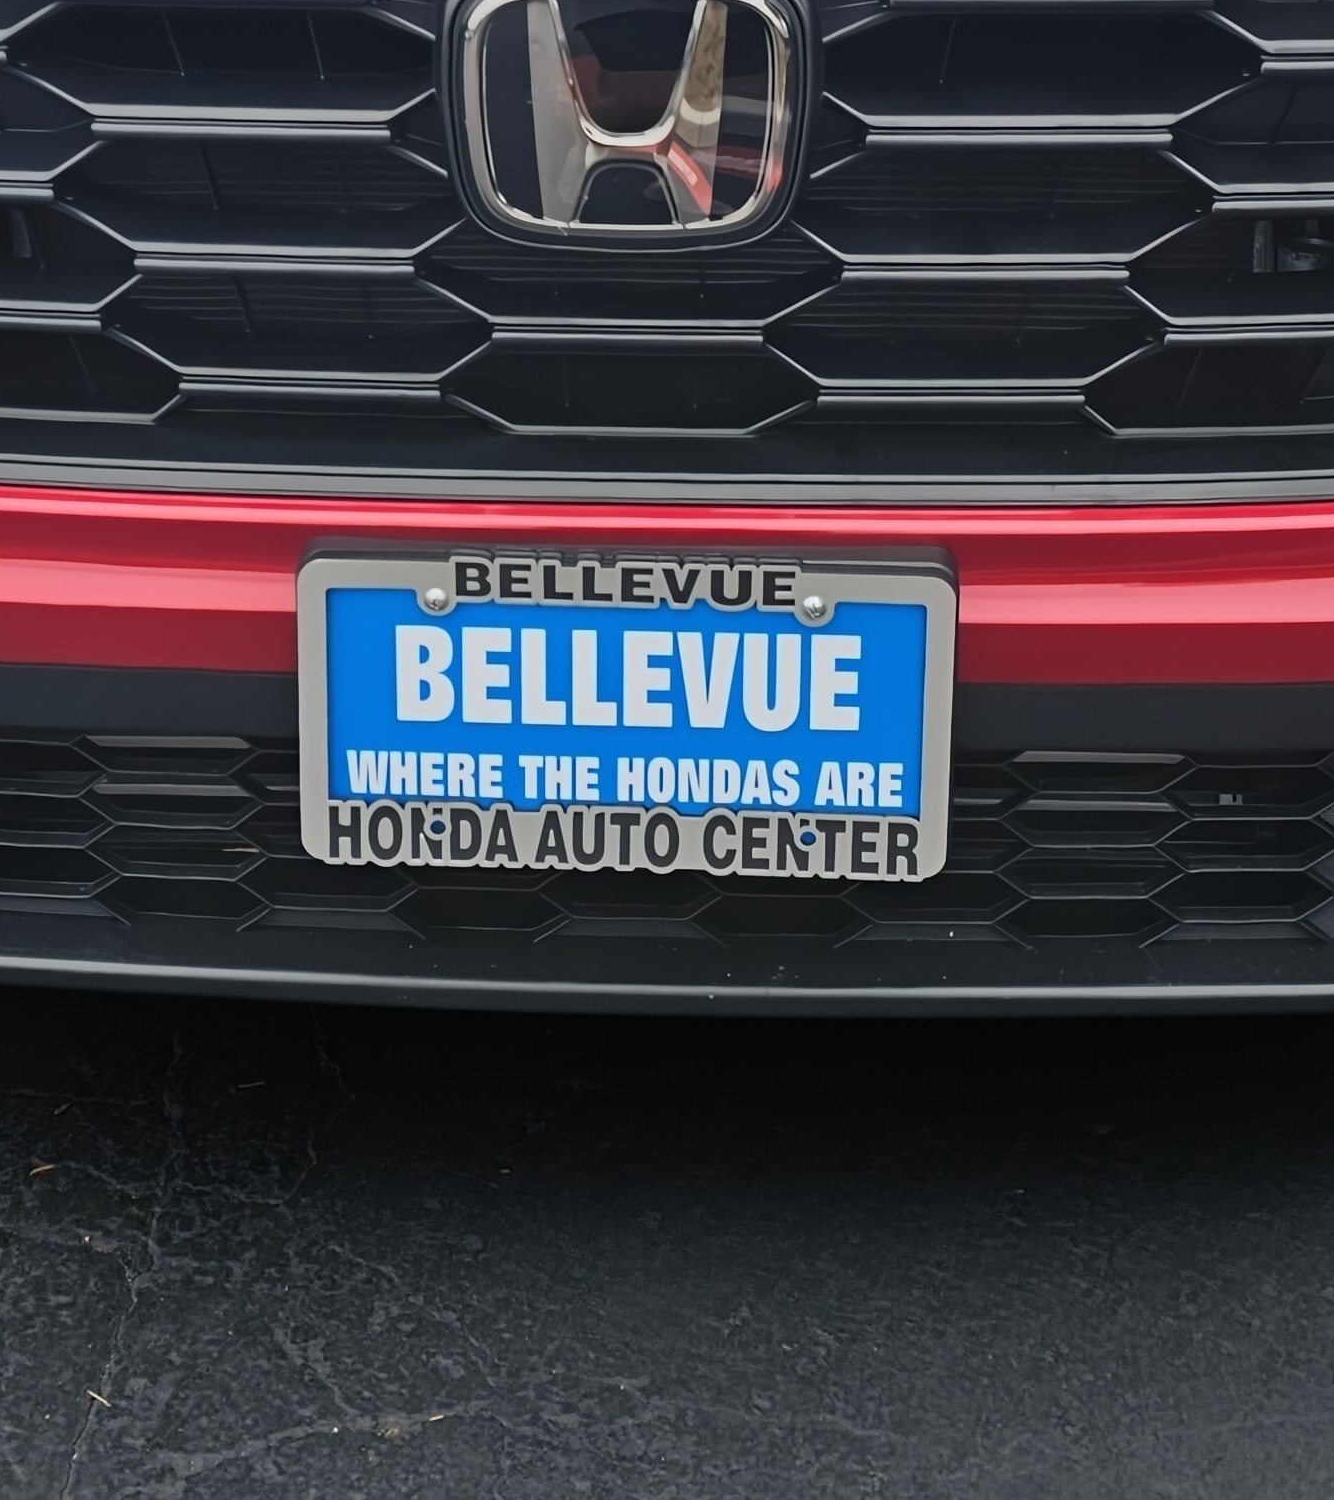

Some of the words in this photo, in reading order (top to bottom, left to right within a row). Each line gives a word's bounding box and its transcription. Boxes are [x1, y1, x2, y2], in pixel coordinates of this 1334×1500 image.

[454, 562, 797, 607] BELLEVUE
[394, 624, 862, 733] BELLEVUE
[346, 749, 503, 798] WHERE
[519, 755, 600, 802] THE
[617, 756, 800, 808] HONDAS
[814, 763, 904, 808] ARE
[328, 805, 519, 864] HONDA
[534, 809, 680, 867] AUTO
[702, 815, 920, 876] CENTER
